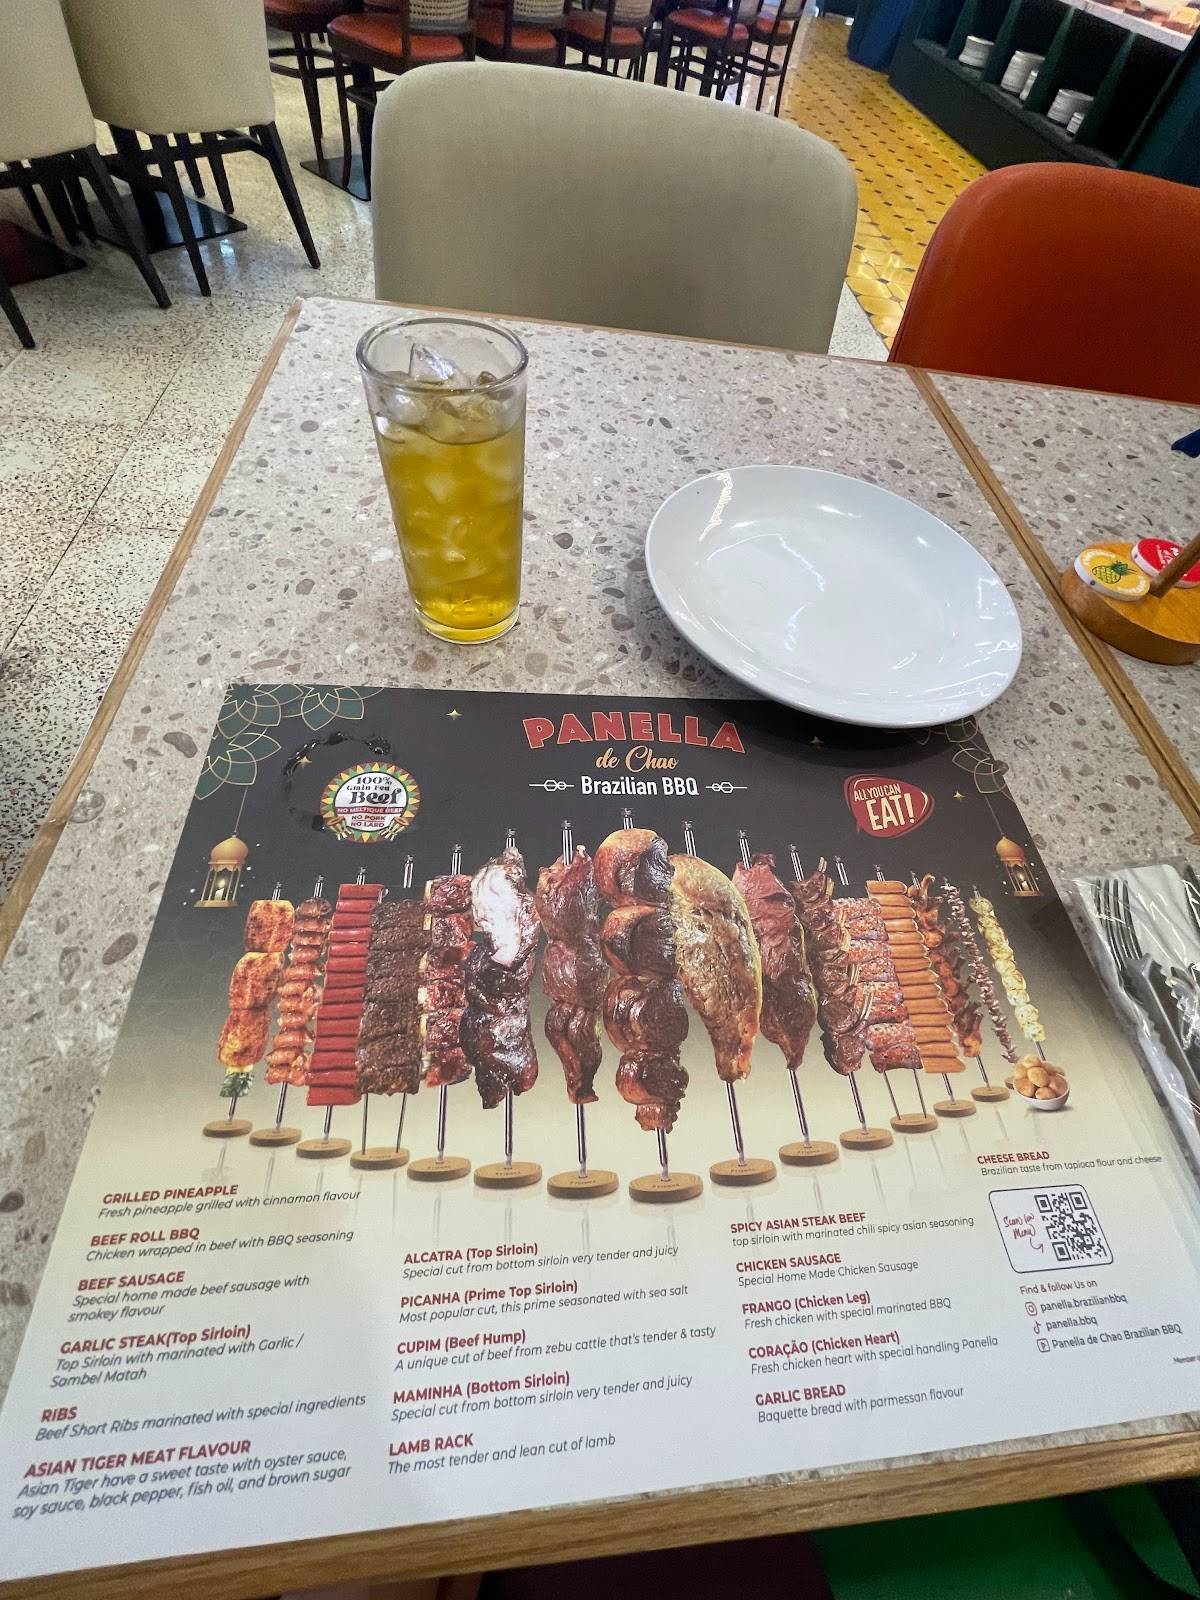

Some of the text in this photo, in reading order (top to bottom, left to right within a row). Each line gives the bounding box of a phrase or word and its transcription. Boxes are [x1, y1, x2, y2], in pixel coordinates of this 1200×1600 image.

[522, 711, 745, 754] PANELLA
[595, 745, 679, 773] de Chao
[356, 776, 392, 785] 100%
[581, 776, 699, 796] Brazilian BBQ
[350, 788, 402, 804] Beef
[854, 783, 902, 802] ALL YOU CAN
[866, 792, 915, 831] EAT!
[977, 1151, 1049, 1164] CHEESE BREAD
[981, 1165, 1018, 1175] Brazilian
[1019, 1164, 1041, 1172] taste
[1042, 1162, 1063, 1171] from
[1064, 1160, 1095, 1170] tapioca
[1095, 1158, 1115, 1166] flour
[1116, 1156, 1133, 1165] and
[98, 1191, 361, 1218] Fresh pineapple grilled with cinnamon flavour
[103, 1184, 238, 1204] GRILLED PINEAPPLE
[730, 1212, 865, 1233] SPICY ASIAN STEAK BEEF
[732, 1216, 974, 1247] top sirloin with marinated chili spicy asian seasoning
[90, 1227, 199, 1247] BEEF ROLL BBQ
[404, 1242, 537, 1264] ALCATRA (Top Sirloin)
[736, 1253, 841, 1272] CHICKEN SAUSAGE
[77, 1271, 185, 1291] BEEF SAUSAGE
[738, 1261, 918, 1288] Special Home Made Chicken Sausage
[72, 1275, 309, 1308] Special home made beef sausage with
[401, 1280, 577, 1308] PICANHA (Prime Top Sirloin)
[1019, 1284, 1039, 1295] Find
[1040, 1284, 1047, 1292] &
[1047, 1282, 1072, 1292] follow
[1073, 1280, 1085, 1289] Us
[67, 1305, 165, 1322] smokey flavour
[742, 1290, 870, 1314] FRANGO (Chicken Leg)
[1040, 1293, 1128, 1313] panella.brazilianbbq
[1045, 1315, 1098, 1331] panella.bbq
[60, 1324, 250, 1354] GARLIC STEAK(Top Sirloin)
[397, 1329, 525, 1354] CUPIM (Beef Hump)
[811, 1336, 862, 1355] (Chicken
[864, 1330, 899, 1345] Heart)
[1052, 1323, 1183, 1350] Panella de Chao Brazilian BBQ
[394, 1326, 716, 1371] A unique cut of beef from zebu cattle that's tender & tasty
[751, 1335, 998, 1374] Fresh chicken heart with special handling Panella
[391, 1374, 692, 1423] Special cut from bottom sirloin very tender and juicy
[393, 1370, 569, 1404] MAMINHA (Bottom Sirloin)
[755, 1384, 845, 1406] GARLIC BREAD
[34, 1394, 366, 1441] Beef Short Ribs marinated with special ingredients
[41, 1406, 77, 1423] RIBS
[389, 1433, 473, 1456] LAMB RACK
[23, 1440, 251, 1479] ASIAN TIGER MEAT FLAVOUR
